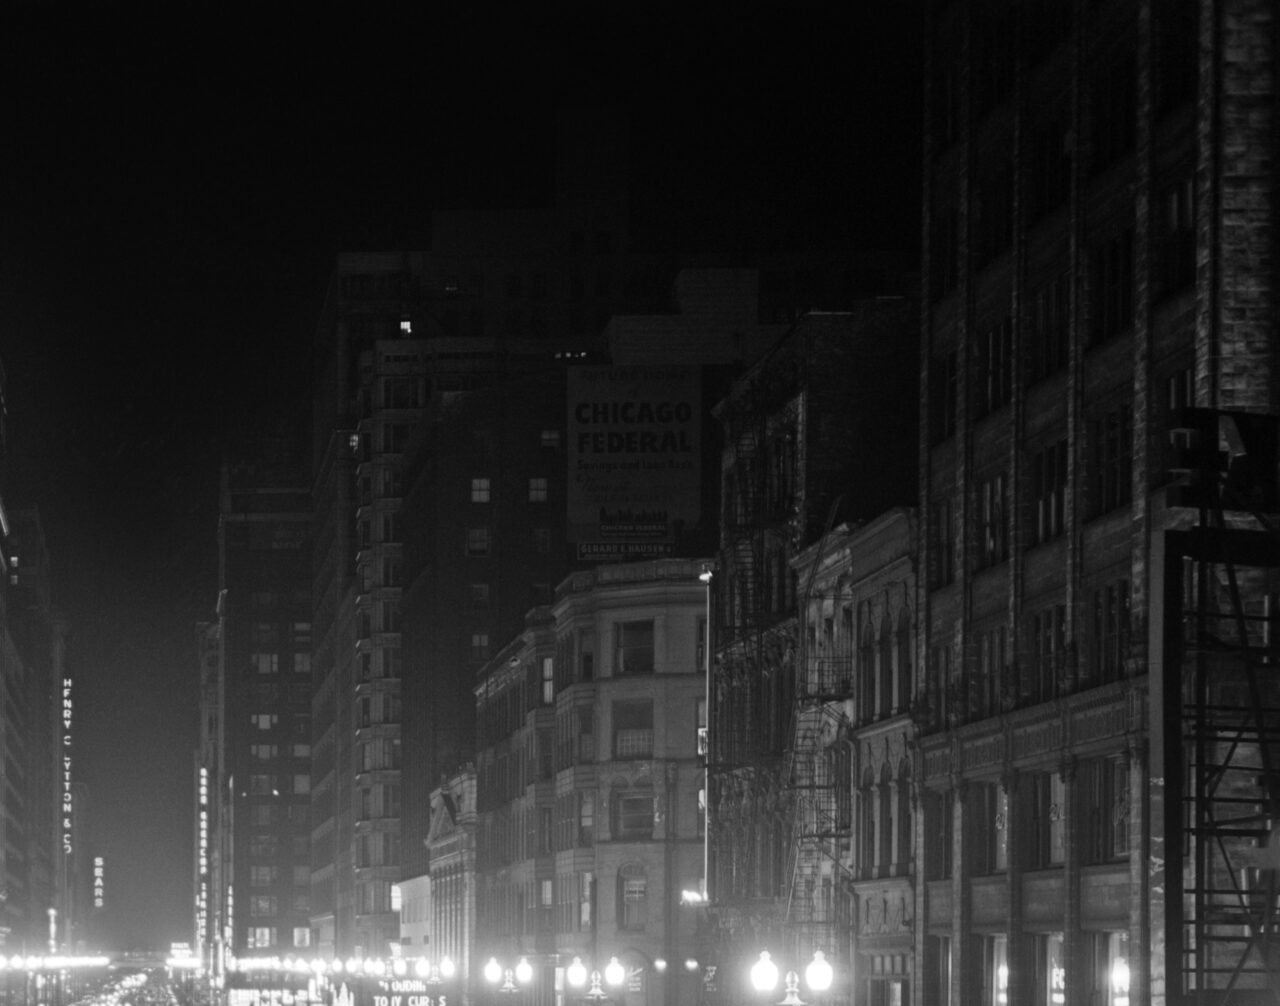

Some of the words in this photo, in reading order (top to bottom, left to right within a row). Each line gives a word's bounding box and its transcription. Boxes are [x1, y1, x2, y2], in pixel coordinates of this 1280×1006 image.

[575, 401, 691, 424] CHICAGO
[577, 431, 691, 454] FEDERAL
[94, 857, 104, 908] SEARS
